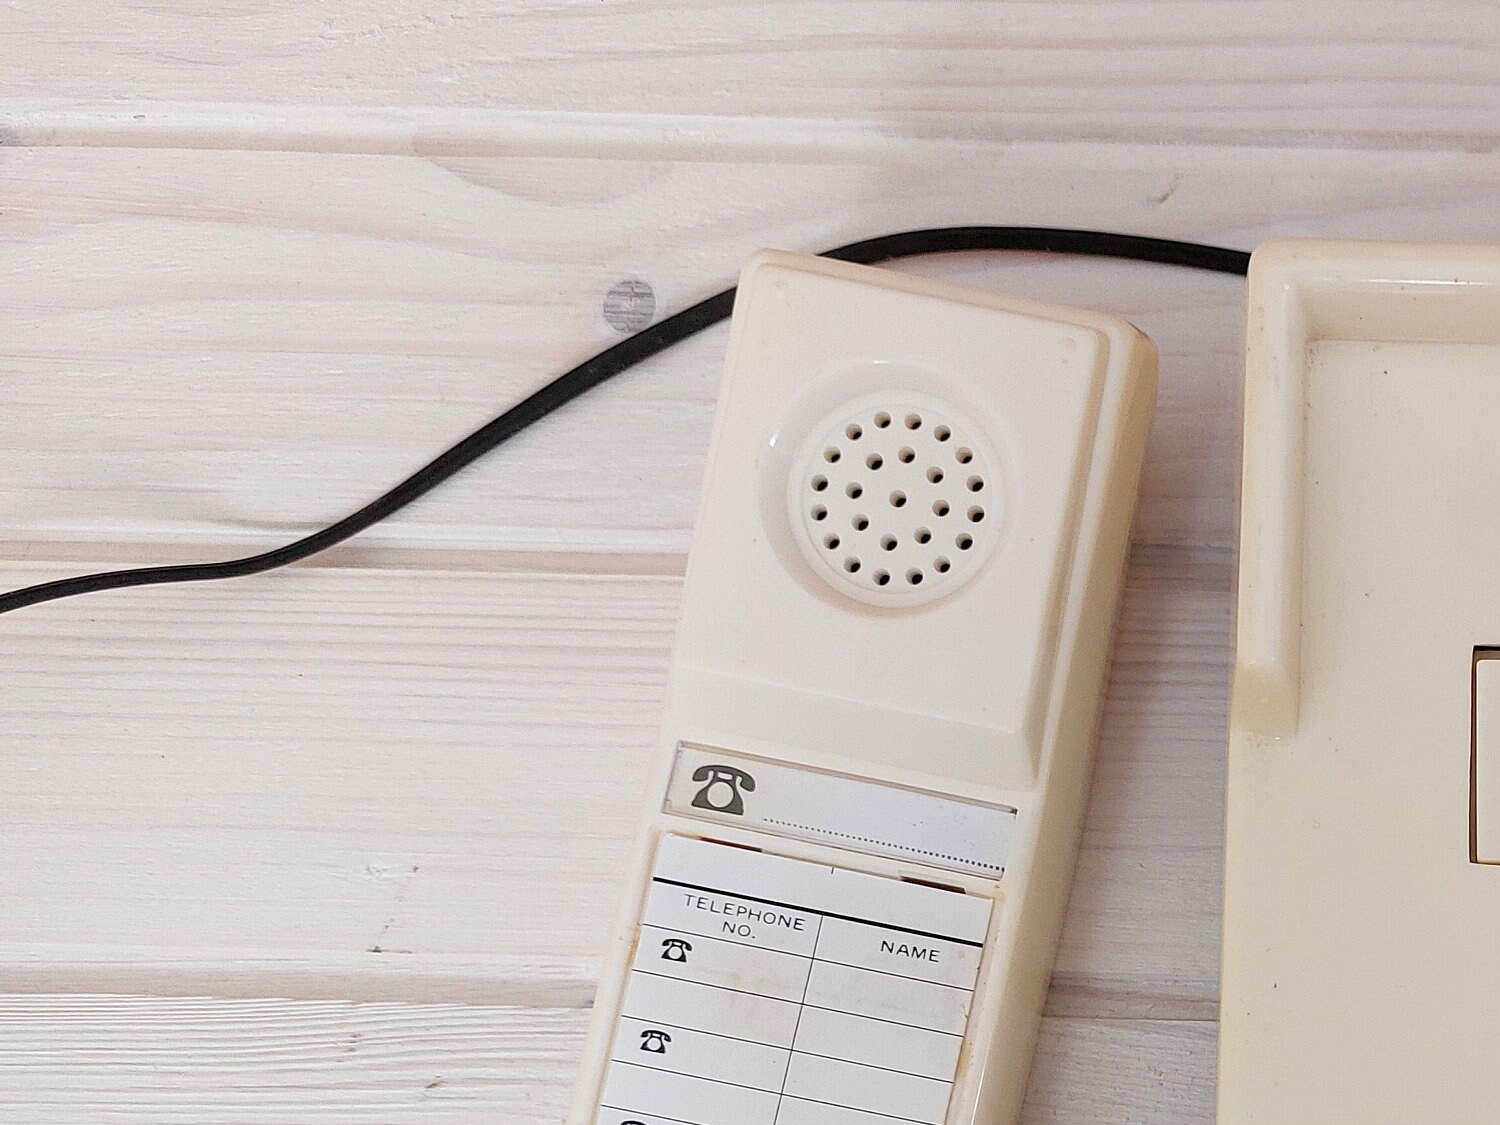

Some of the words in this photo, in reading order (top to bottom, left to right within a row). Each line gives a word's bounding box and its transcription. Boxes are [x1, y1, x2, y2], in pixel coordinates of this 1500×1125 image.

[684, 893, 806, 931] TELEPHONE
[722, 920, 756, 940] NO.
[880, 939, 941, 963] NAME
